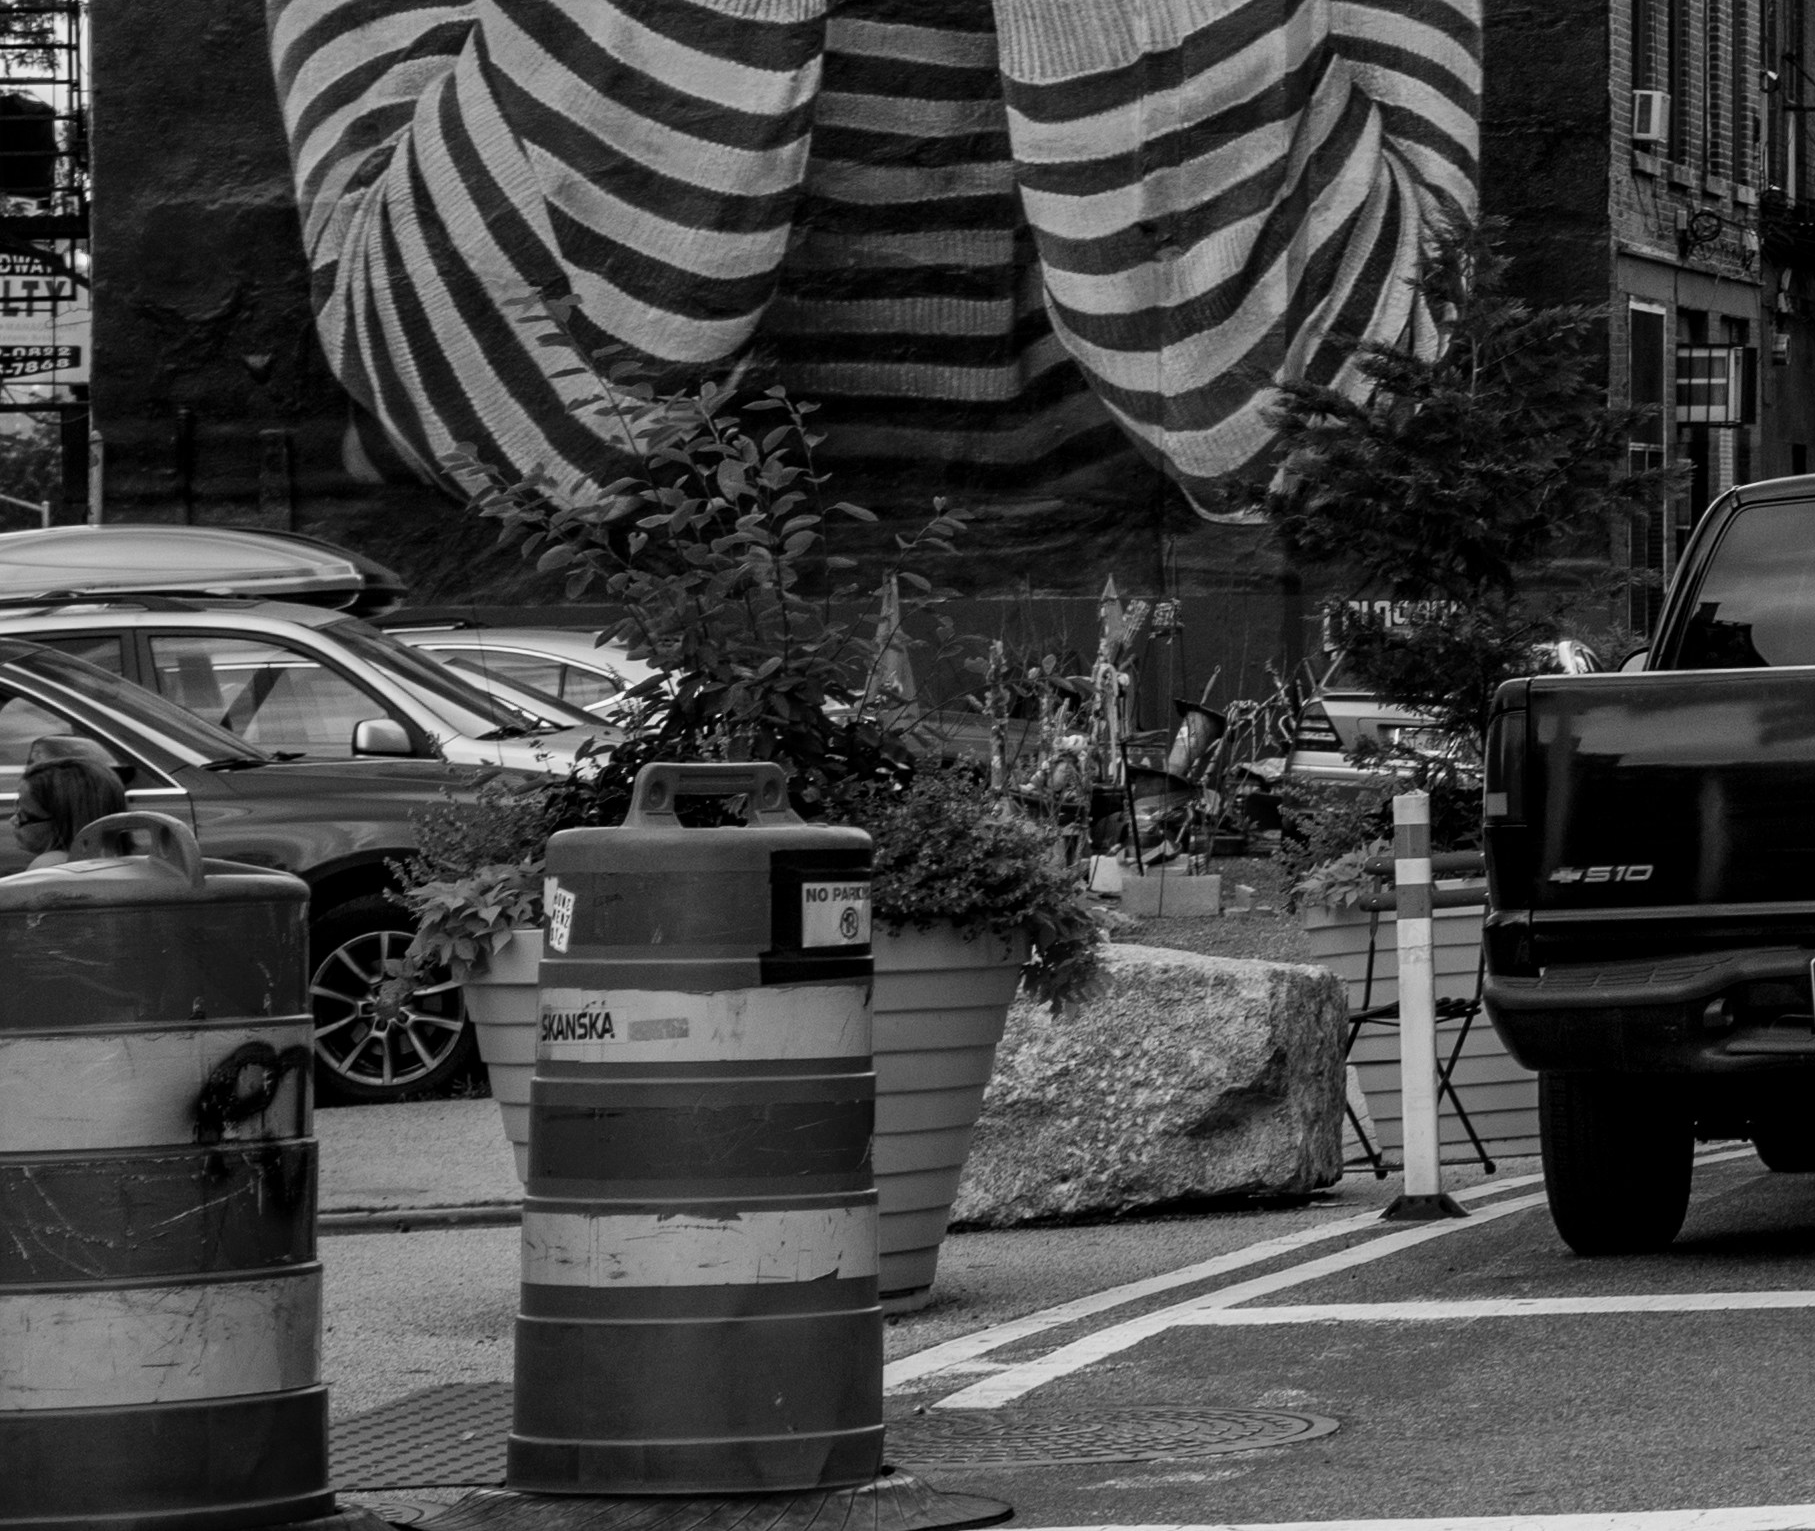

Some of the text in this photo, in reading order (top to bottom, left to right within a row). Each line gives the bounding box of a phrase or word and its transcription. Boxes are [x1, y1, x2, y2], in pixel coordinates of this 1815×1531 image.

[1583, 864, 1654, 883] S10
[805, 887, 828, 903] NO
[541, 1011, 616, 1042] SKANSKA
